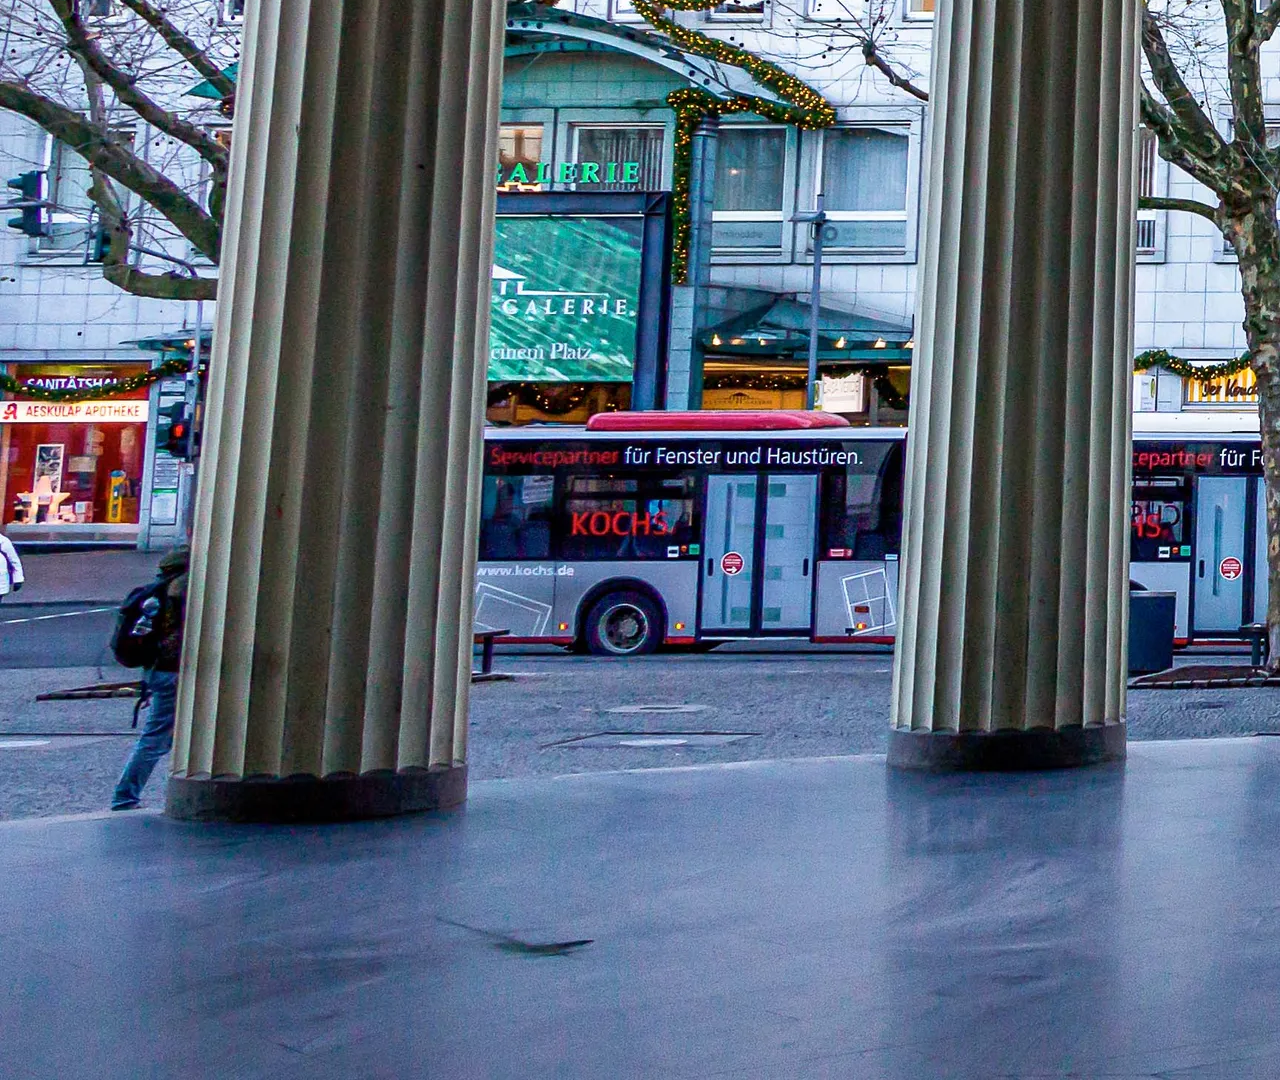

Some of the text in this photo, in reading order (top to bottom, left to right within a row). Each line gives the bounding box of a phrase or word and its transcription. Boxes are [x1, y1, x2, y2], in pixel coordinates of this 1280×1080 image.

[502, 299, 628, 315] GALERIE
[550, 342, 594, 360] Platz
[26, 405, 82, 418] AESKULAP
[86, 405, 140, 417] APOTHEKE
[490, 446, 863, 468] Servicepartner für Fenster und Haustüren.
[1220, 448, 1246, 467] für
